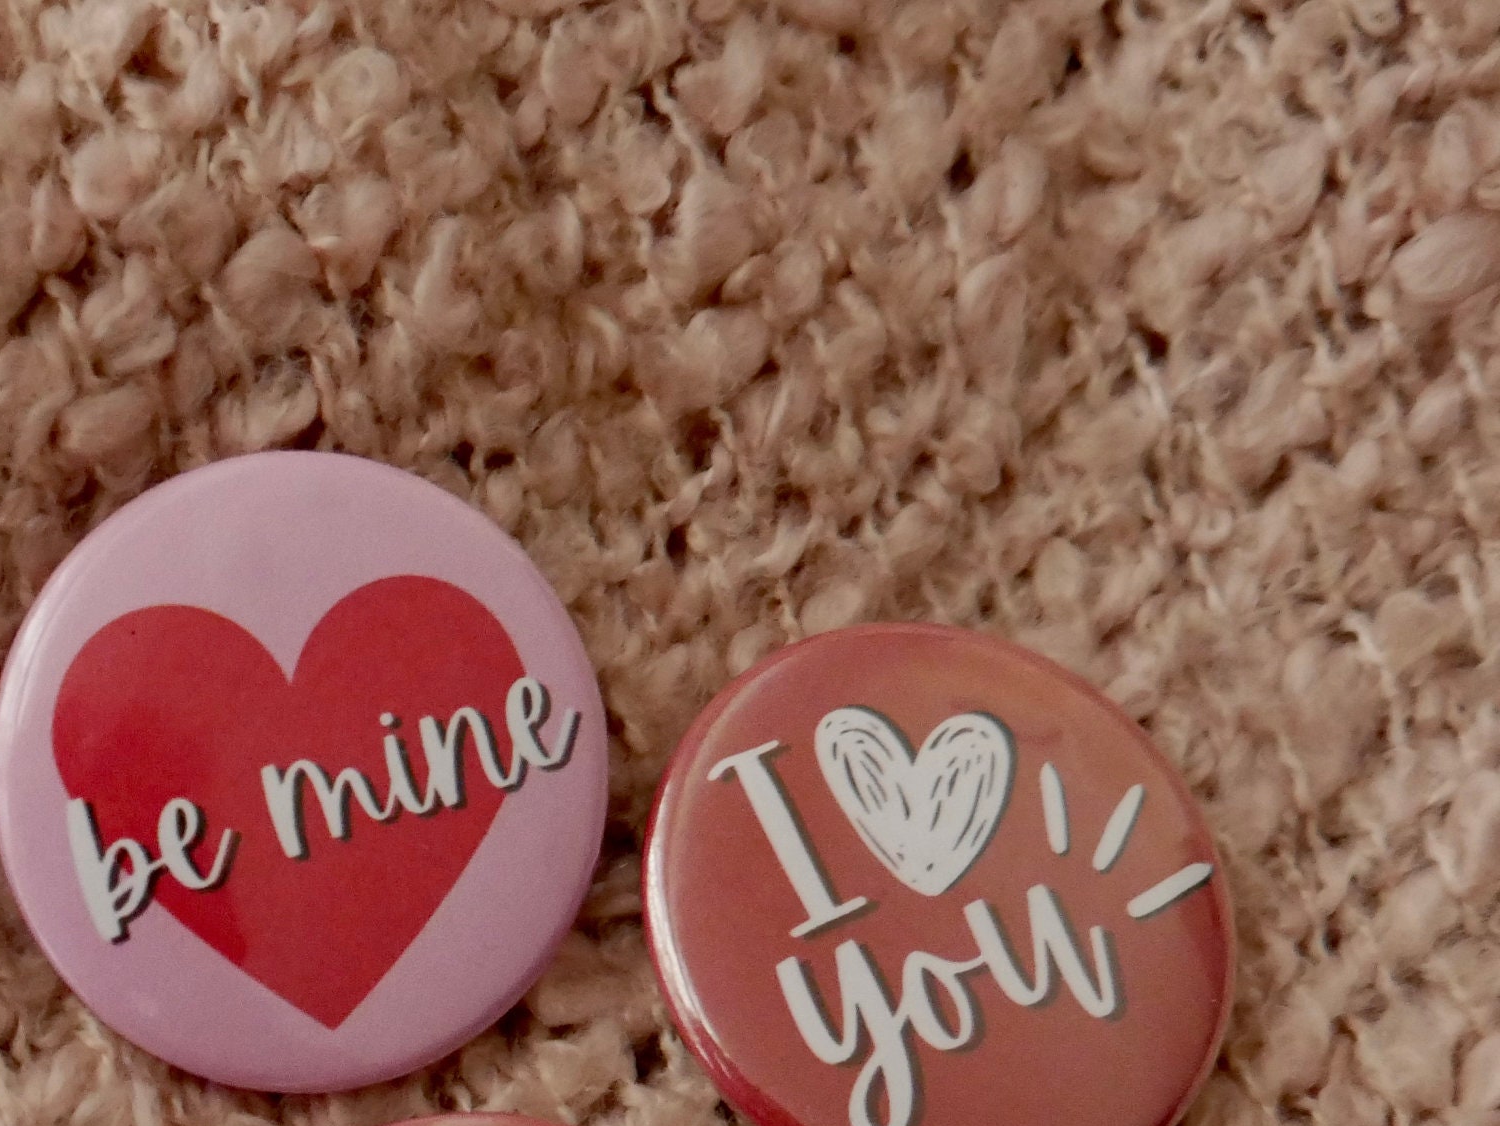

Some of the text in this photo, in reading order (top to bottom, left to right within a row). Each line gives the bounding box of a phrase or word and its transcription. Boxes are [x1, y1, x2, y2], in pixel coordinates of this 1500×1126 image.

[66, 676, 582, 945] be mine
[706, 739, 869, 938] I
